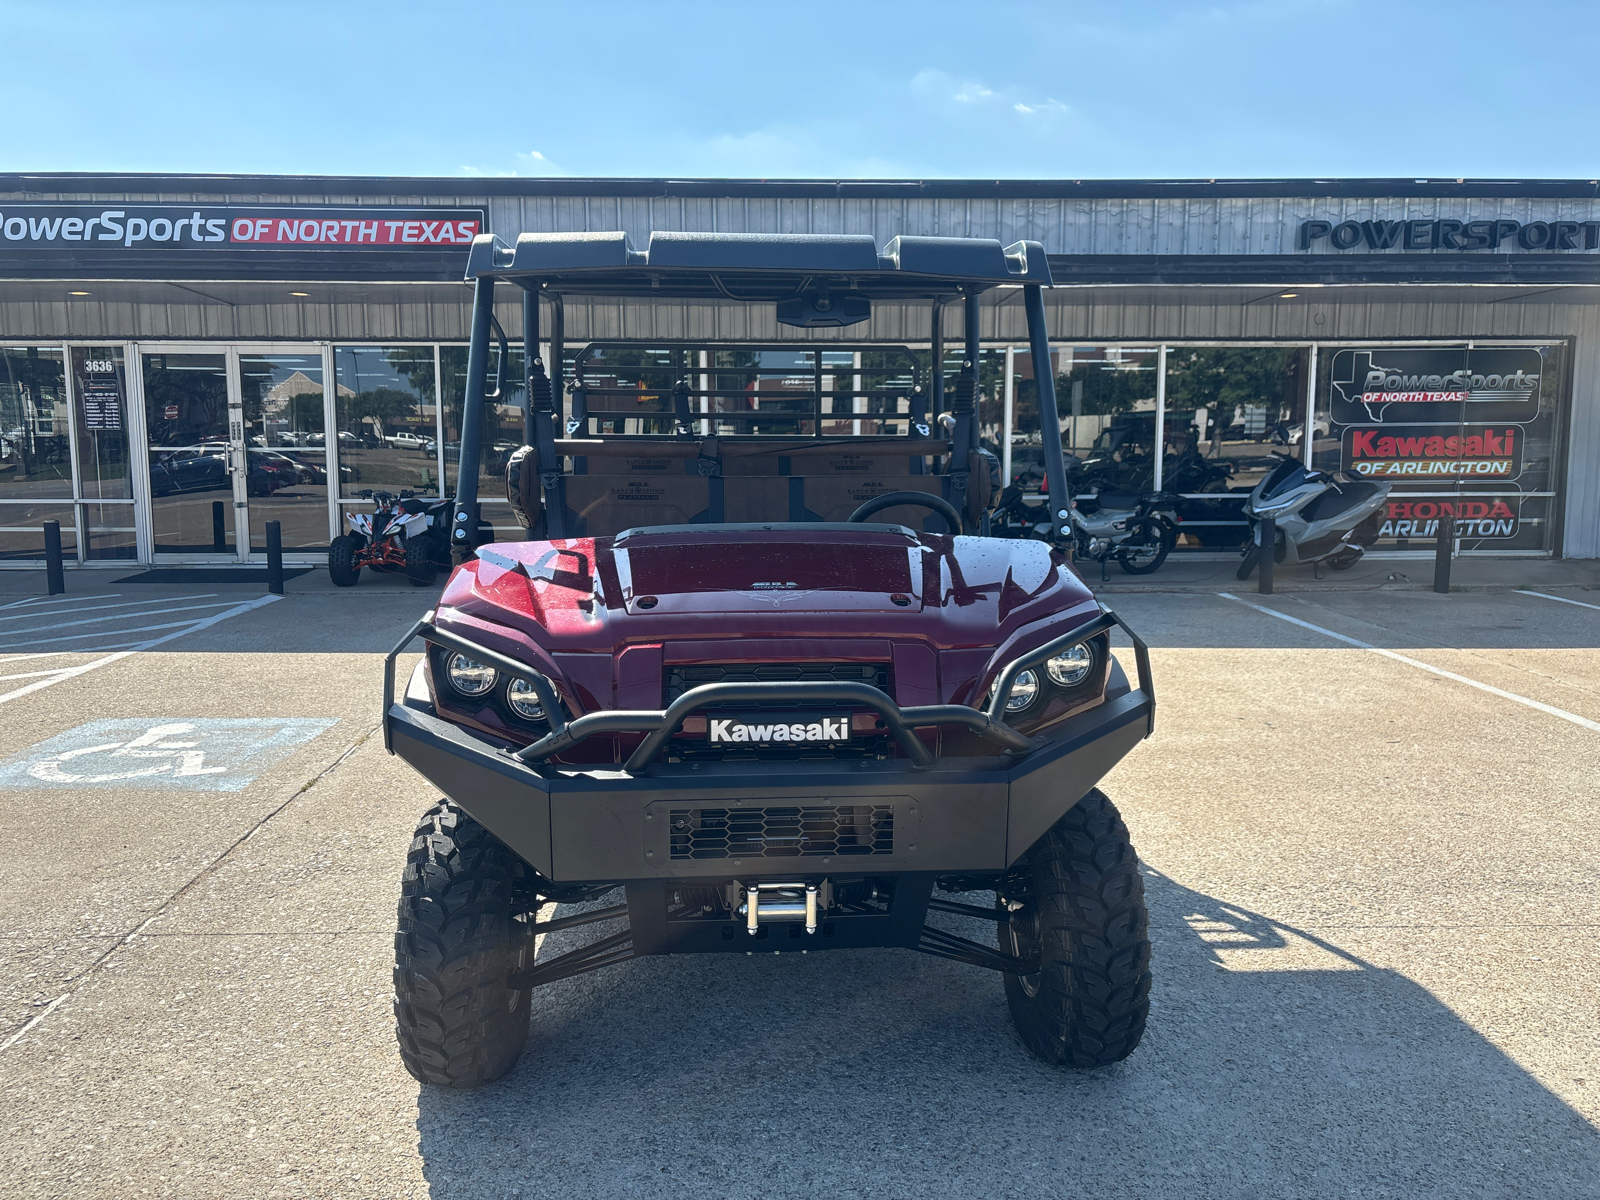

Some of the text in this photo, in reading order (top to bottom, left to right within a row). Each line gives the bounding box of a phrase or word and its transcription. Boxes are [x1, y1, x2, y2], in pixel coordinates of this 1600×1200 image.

[0, 211, 475, 247] owerSports OF NORTH TEXAS
[1301, 219, 1600, 250] POWERSPORT
[85, 360, 112, 372] 3636
[1363, 370, 1539, 391] PowerSports
[1363, 392, 1463, 402] OF NORTH TEXAS
[1352, 430, 1514, 457] Kawasaki
[1356, 461, 1508, 474] OF ARLINGTON
[1386, 502, 1514, 518] HONDA
[710, 717, 848, 742] Kawasaki
